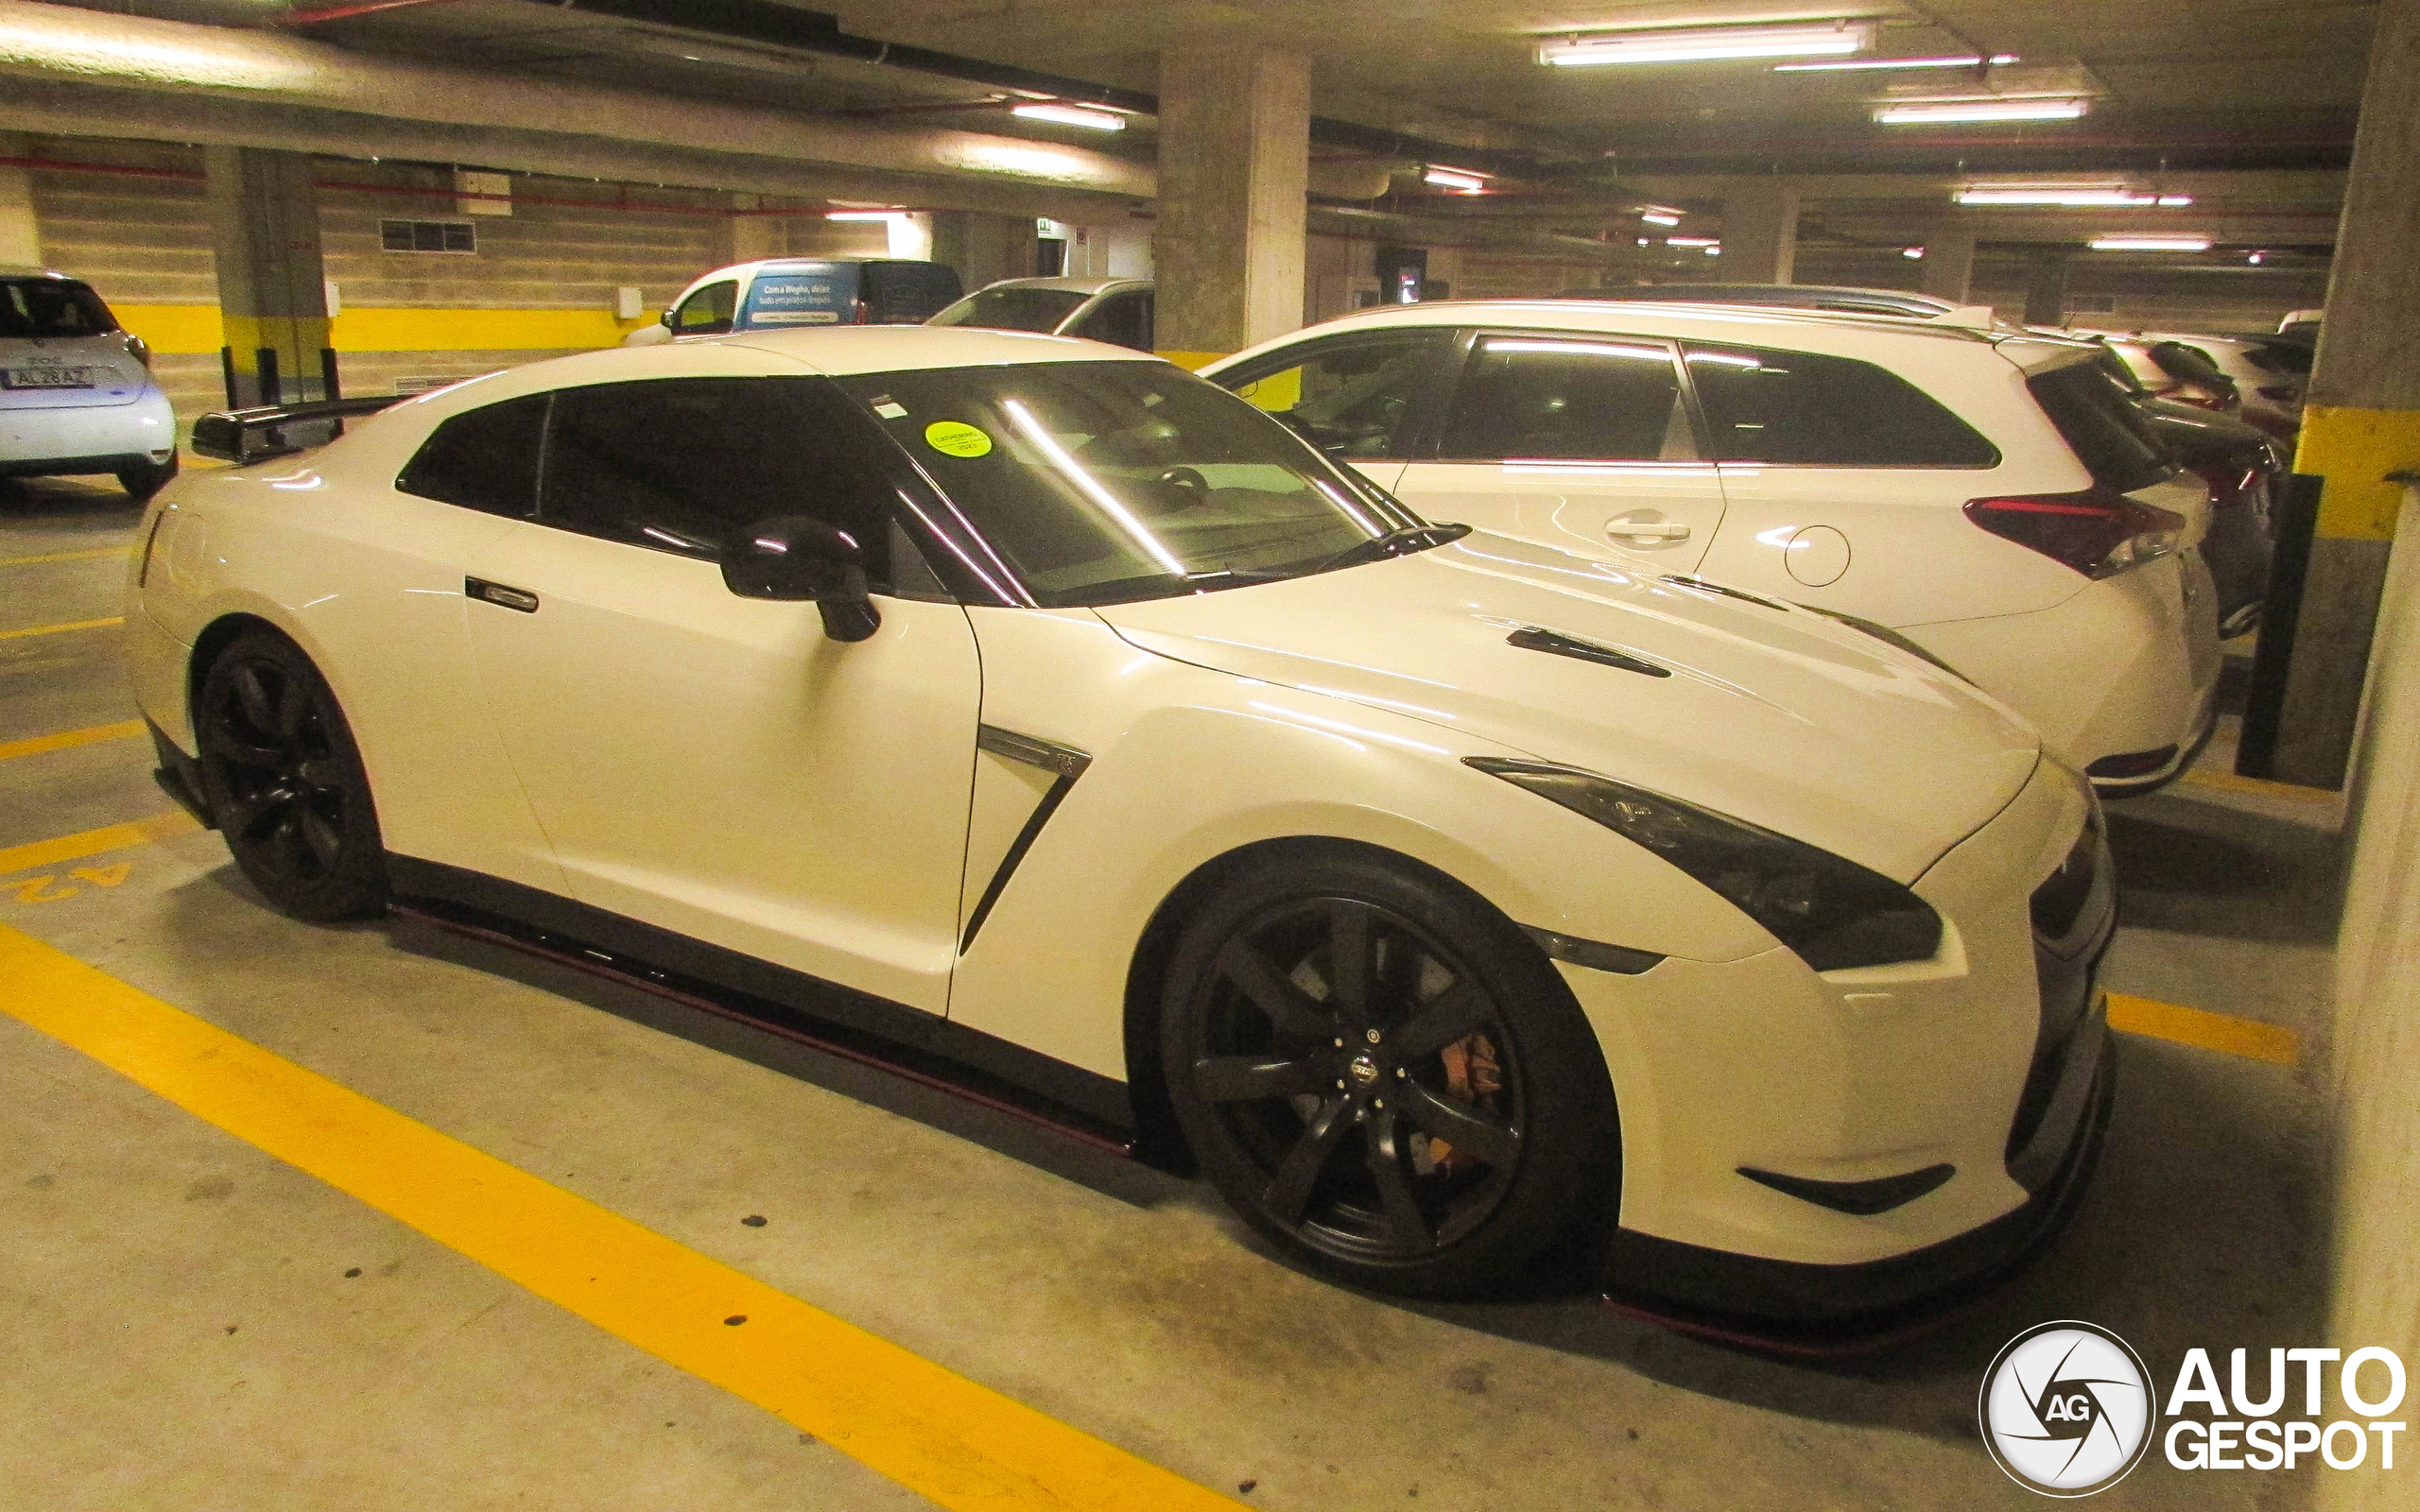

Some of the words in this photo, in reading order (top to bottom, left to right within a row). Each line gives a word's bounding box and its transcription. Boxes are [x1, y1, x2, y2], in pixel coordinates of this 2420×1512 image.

[764, 285, 780, 294] Com
[19, 370, 40, 385] AL
[41, 369, 60, 384] 28
[63, 369, 86, 384] AZ
